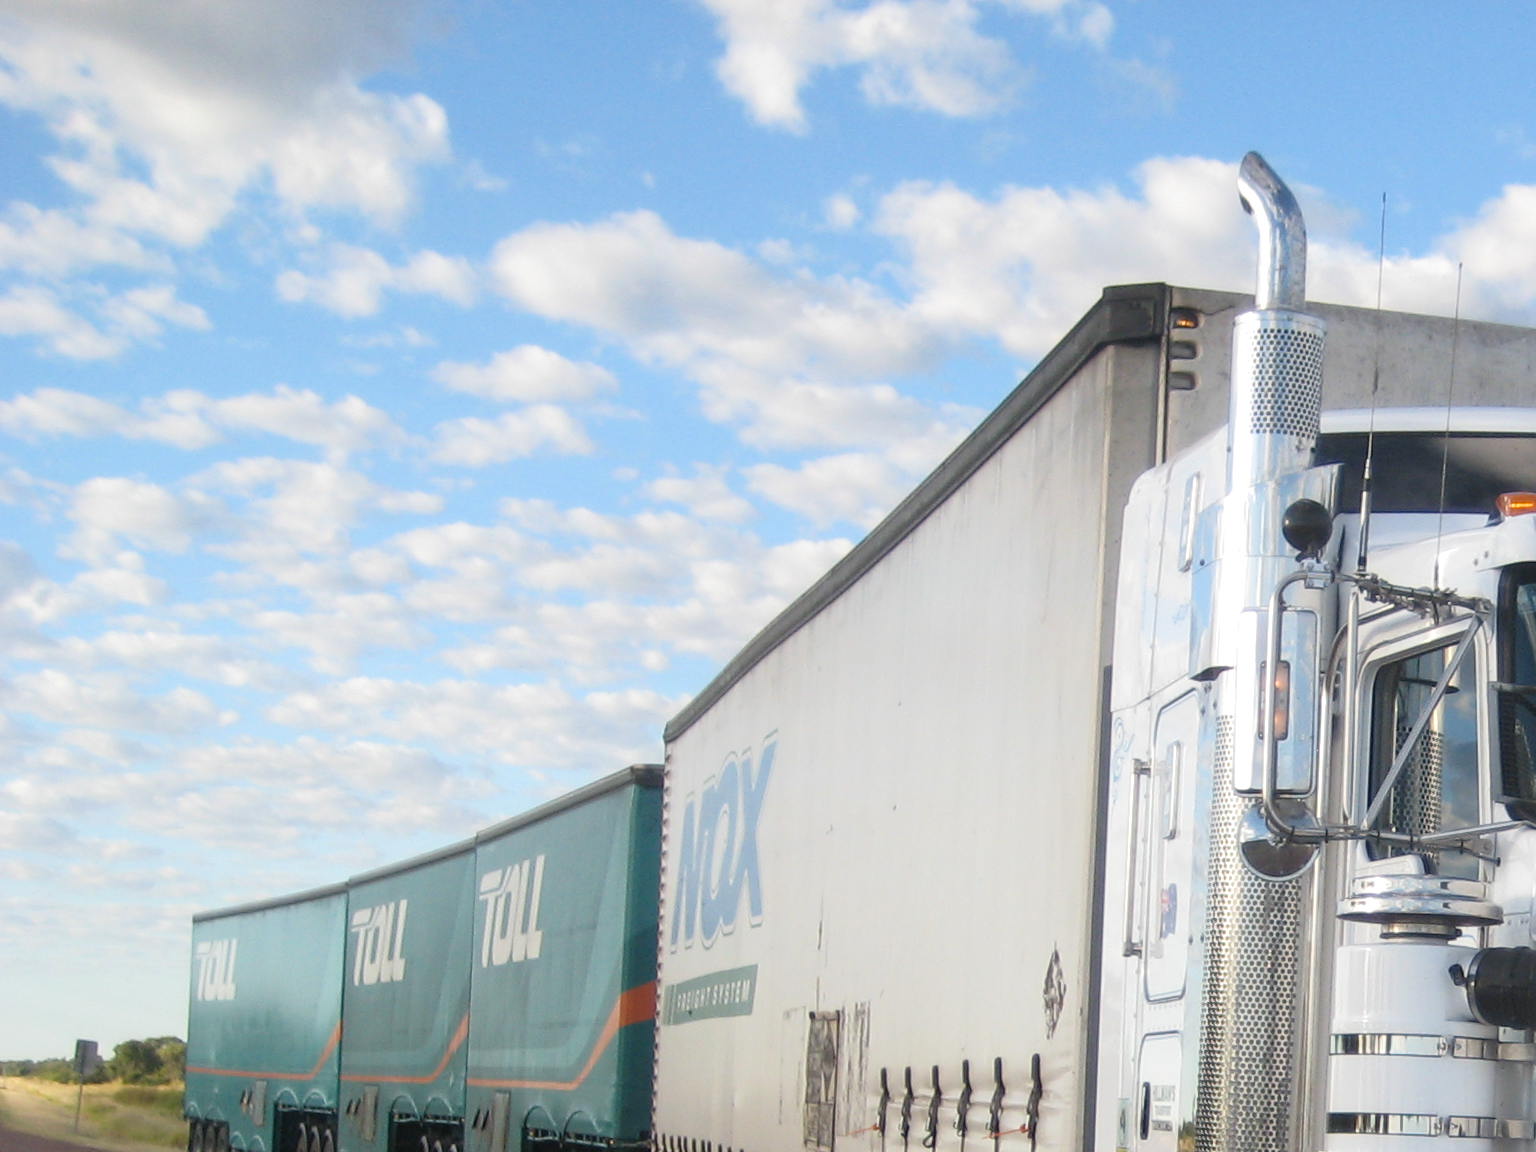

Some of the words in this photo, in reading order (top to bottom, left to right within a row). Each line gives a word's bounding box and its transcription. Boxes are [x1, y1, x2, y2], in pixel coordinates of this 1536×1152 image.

[351, 899, 408, 986] TOLL
[479, 855, 545, 968] TOLL
[195, 938, 237, 1001] TOLL
[676, 986, 711, 1011] FREIGHT
[712, 979, 751, 1006] SYSTEM
